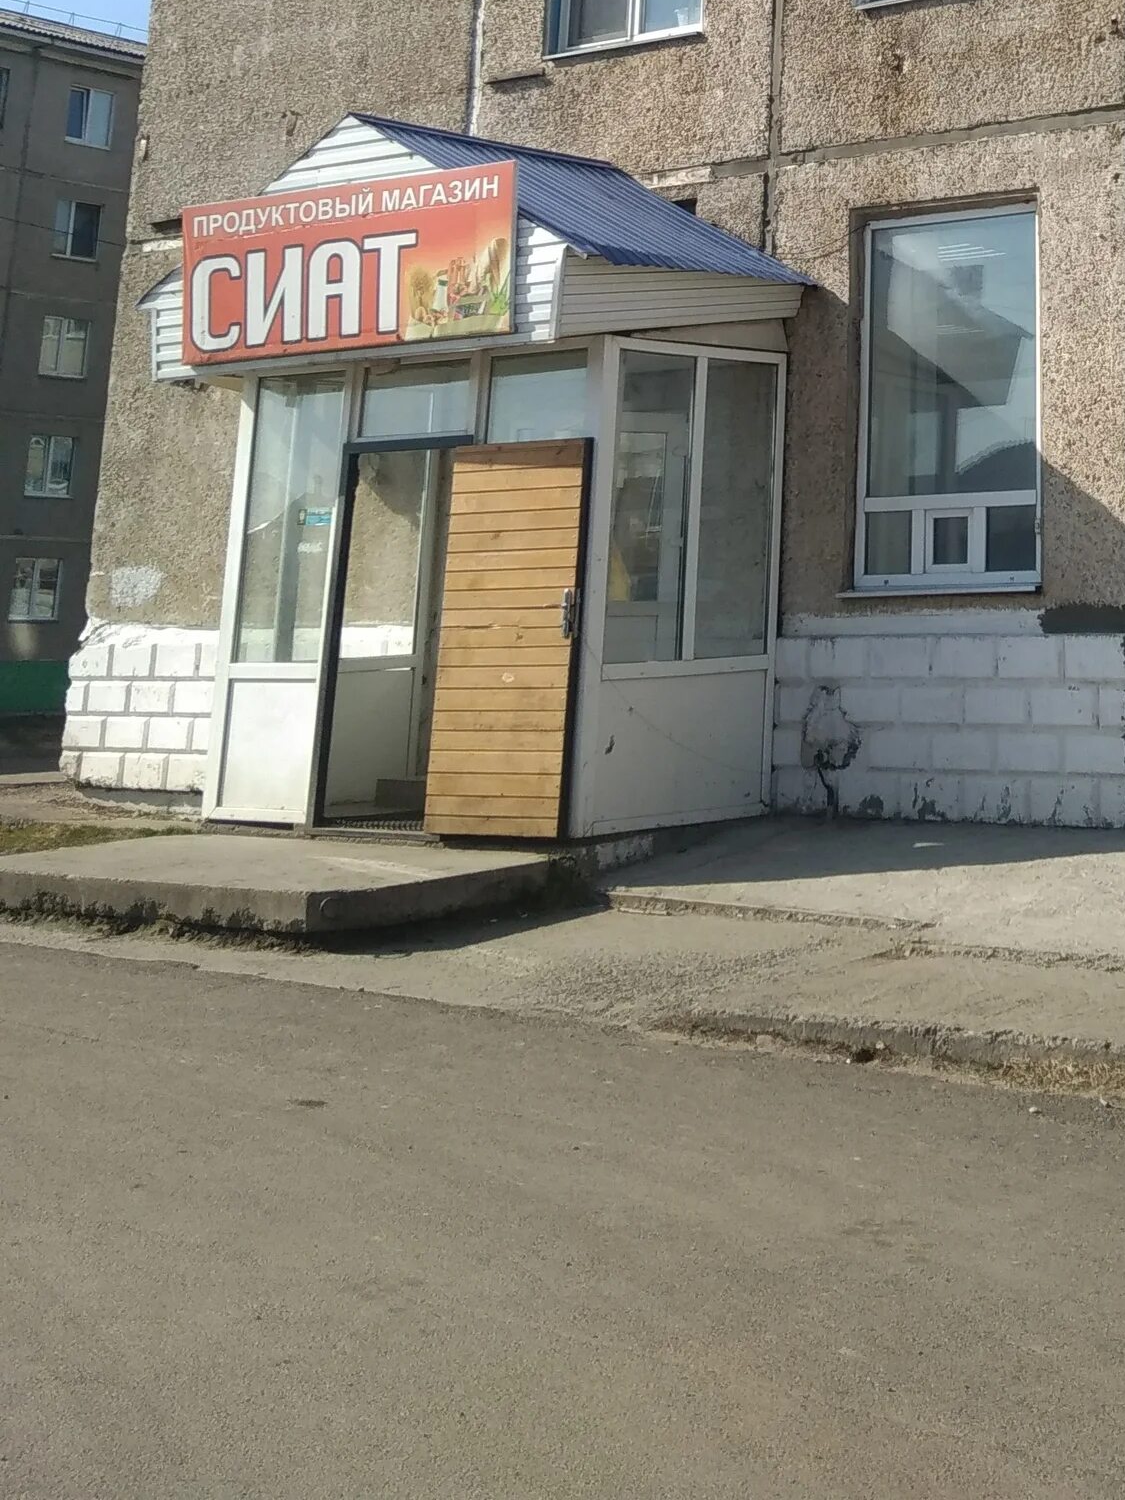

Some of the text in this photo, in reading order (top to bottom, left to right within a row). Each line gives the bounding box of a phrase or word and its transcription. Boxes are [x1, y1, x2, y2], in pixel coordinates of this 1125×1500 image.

[192, 175, 500, 238] ПРОДУКТОВЫЙ МАГАЗИН
[190, 229, 419, 353] СИАТ
